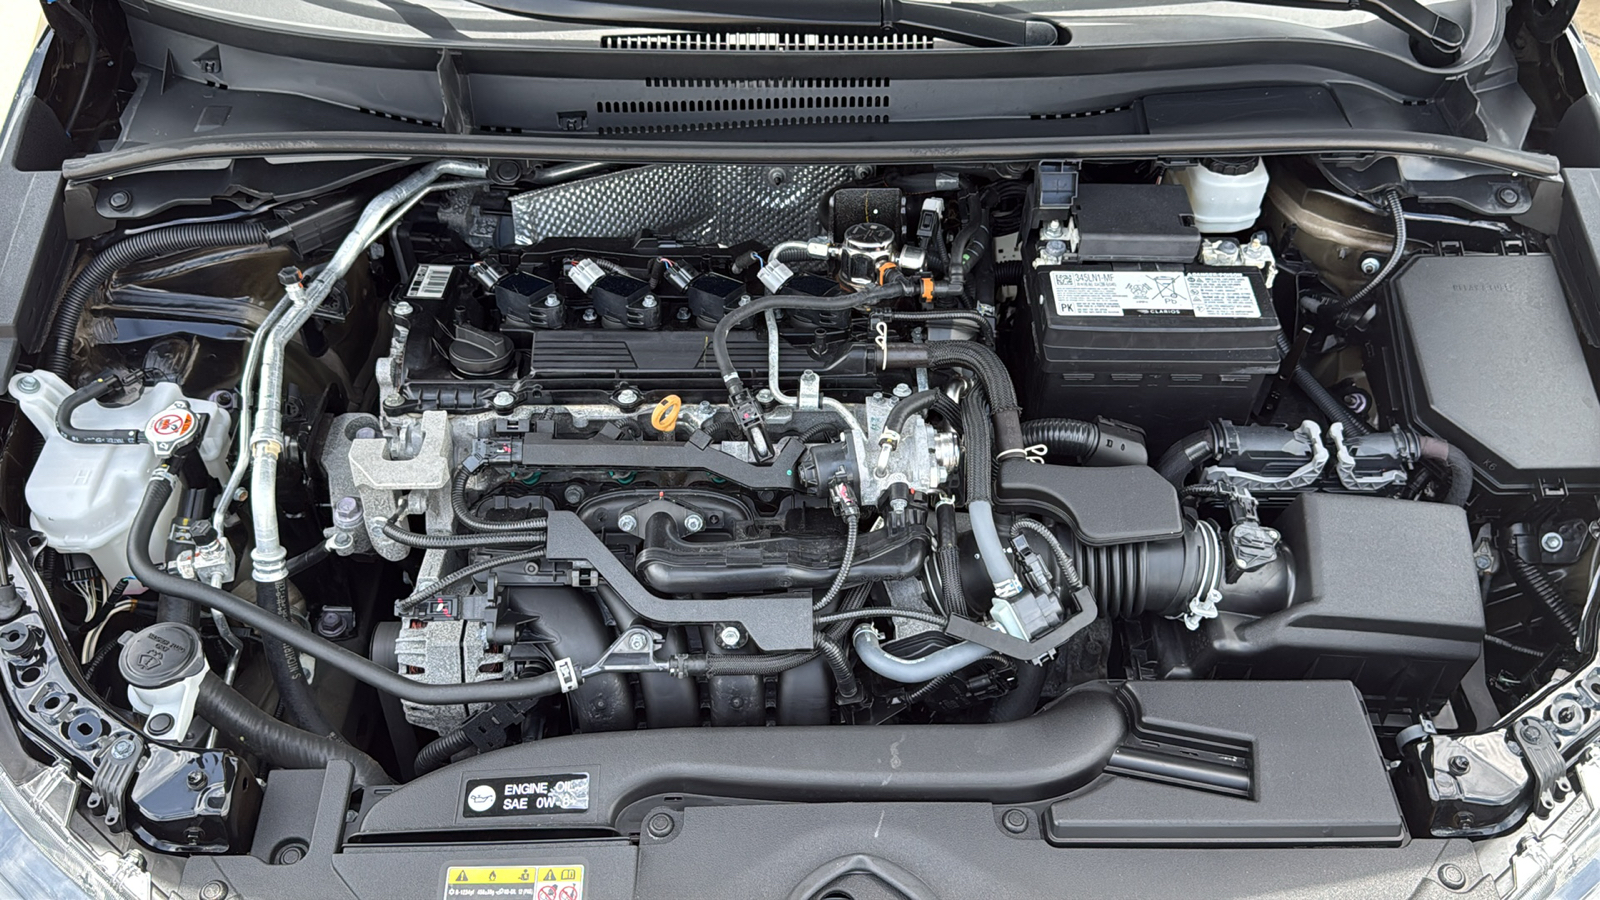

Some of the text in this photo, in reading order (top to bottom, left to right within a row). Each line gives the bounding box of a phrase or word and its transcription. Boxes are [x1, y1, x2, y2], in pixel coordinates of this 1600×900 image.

[1075, 273, 1114, 282] 345LN1-MF
[1061, 303, 1074, 312] PK
[73, 469, 91, 485] H
[504, 780, 575, 795] ENGINE OIL
[503, 798, 528, 810] SAE
